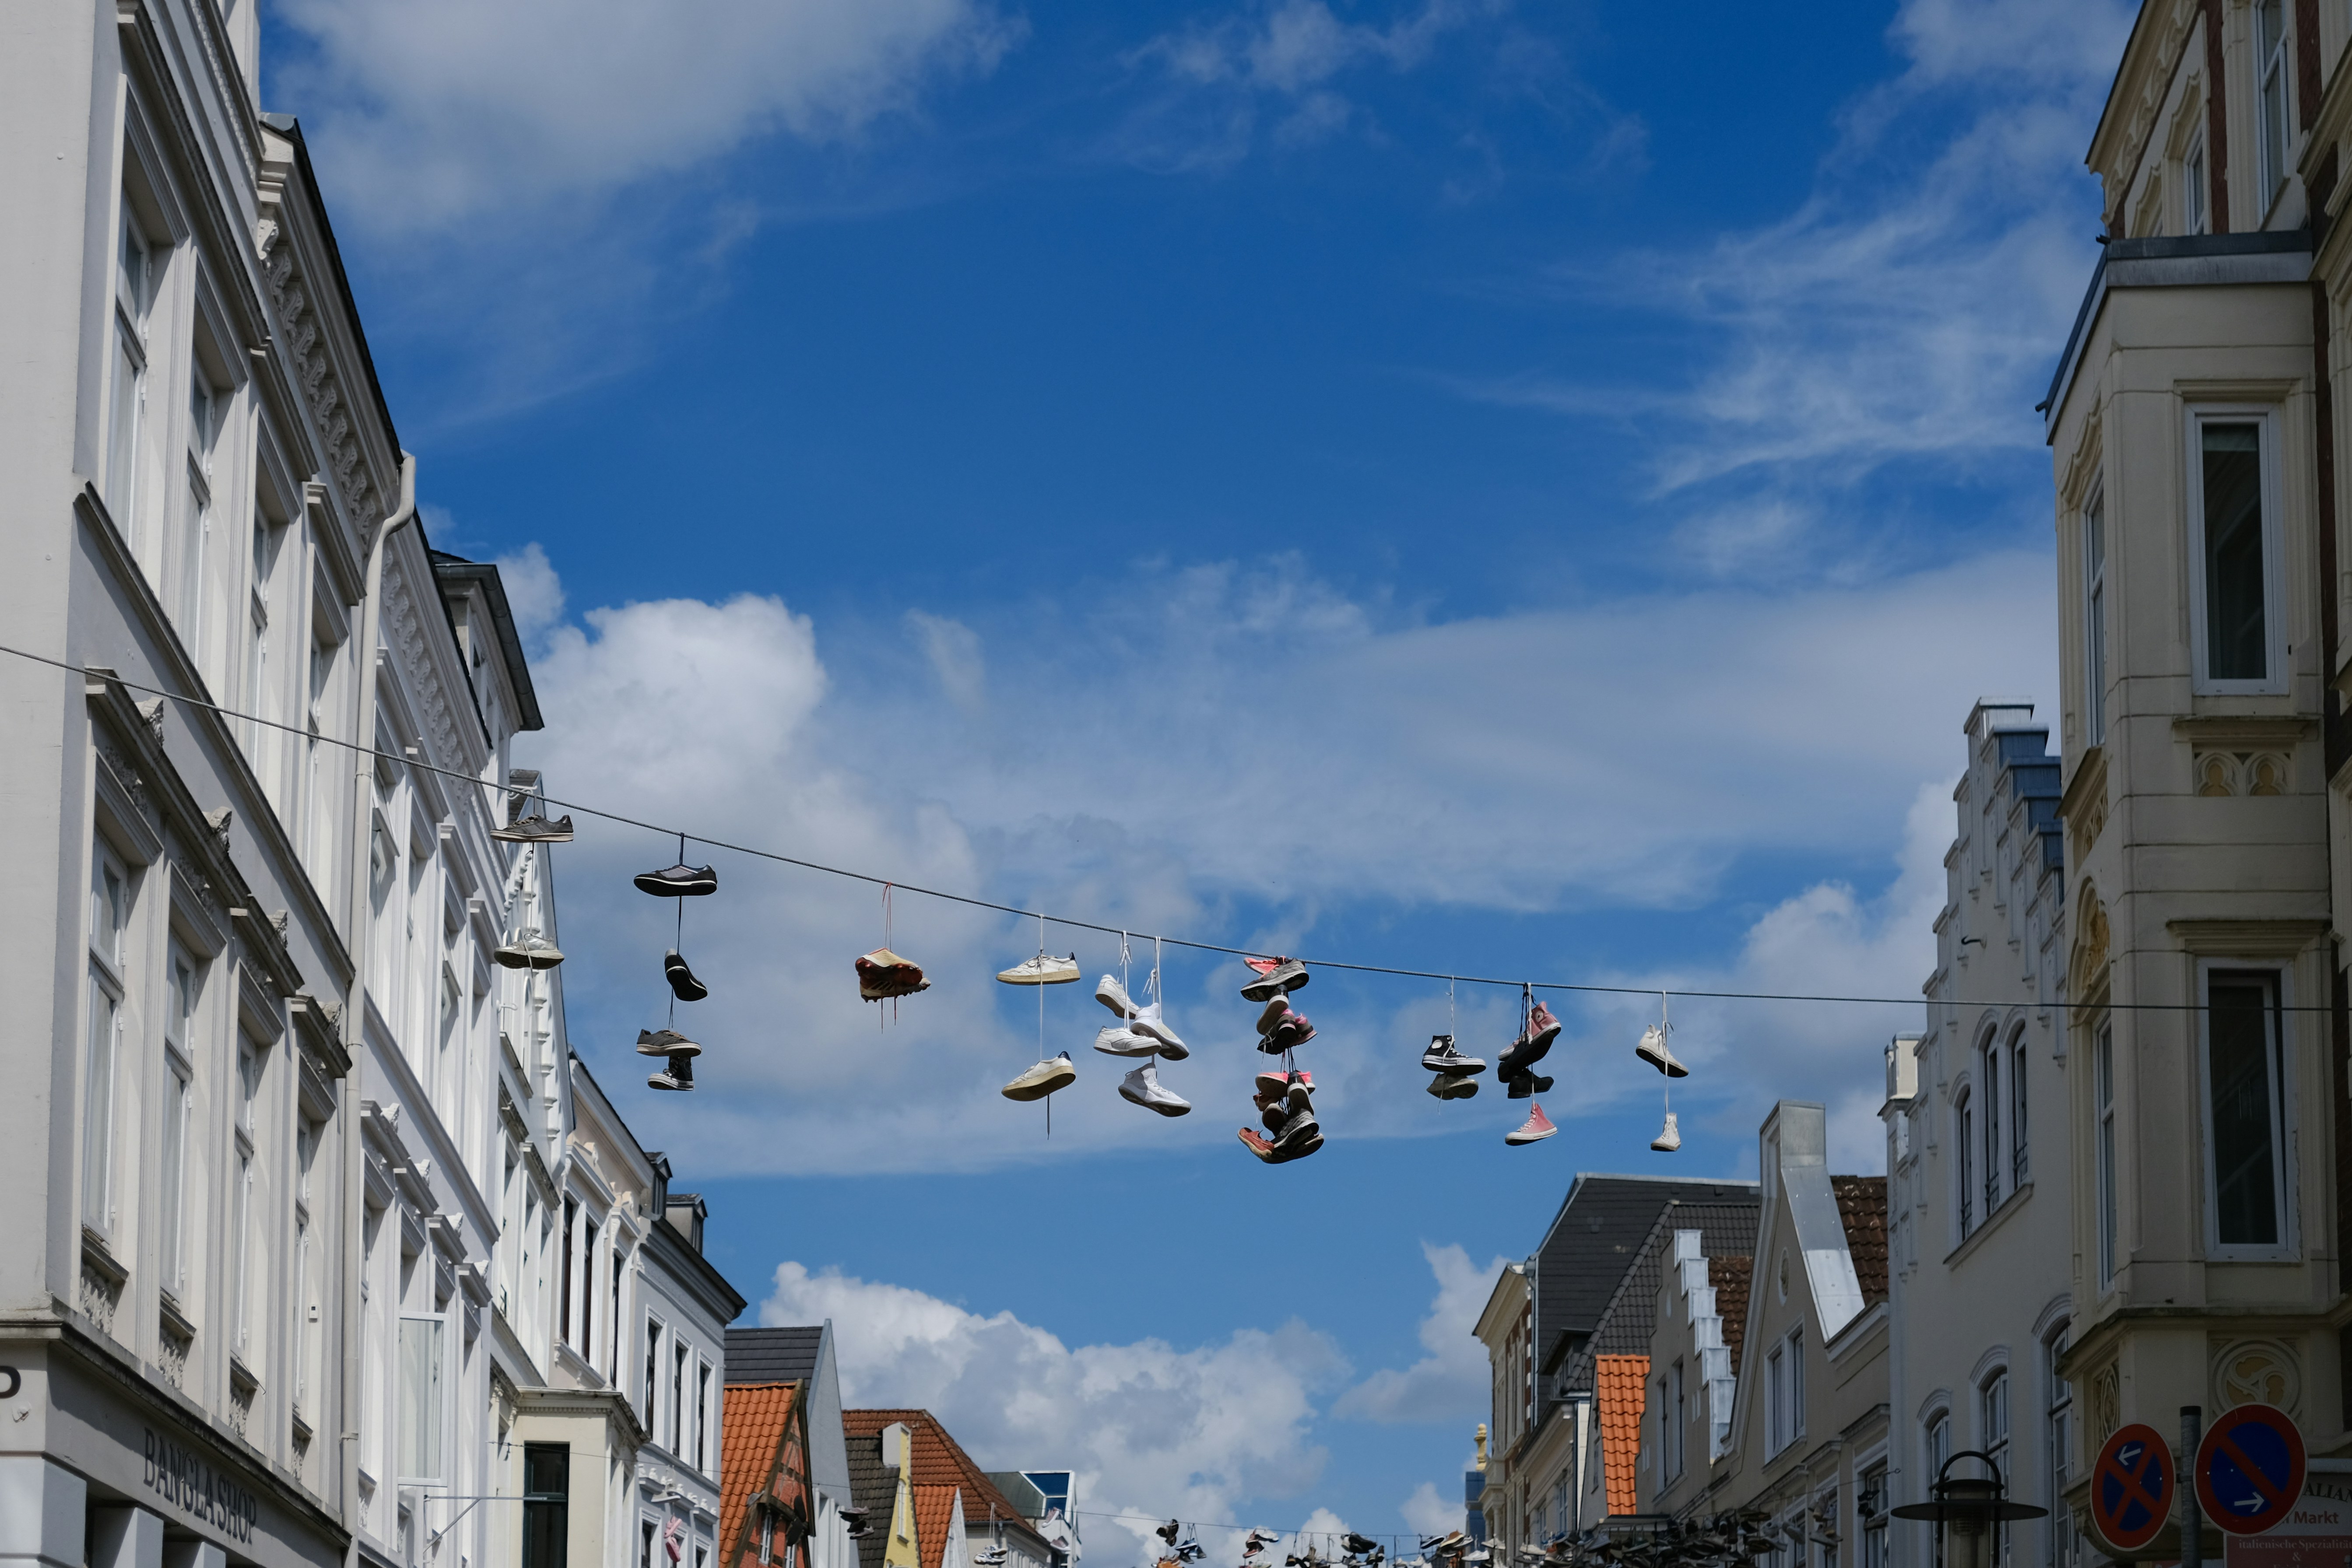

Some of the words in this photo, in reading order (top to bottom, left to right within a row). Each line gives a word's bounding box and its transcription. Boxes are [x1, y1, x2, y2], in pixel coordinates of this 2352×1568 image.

[143, 1427, 215, 1526] BANGLA
[218, 1473, 256, 1545] SHOP
[2294, 1510, 2339, 1524] Markt
[2239, 1539, 2297, 1549] italienische
[2292, 1552, 2301, 1561] &
